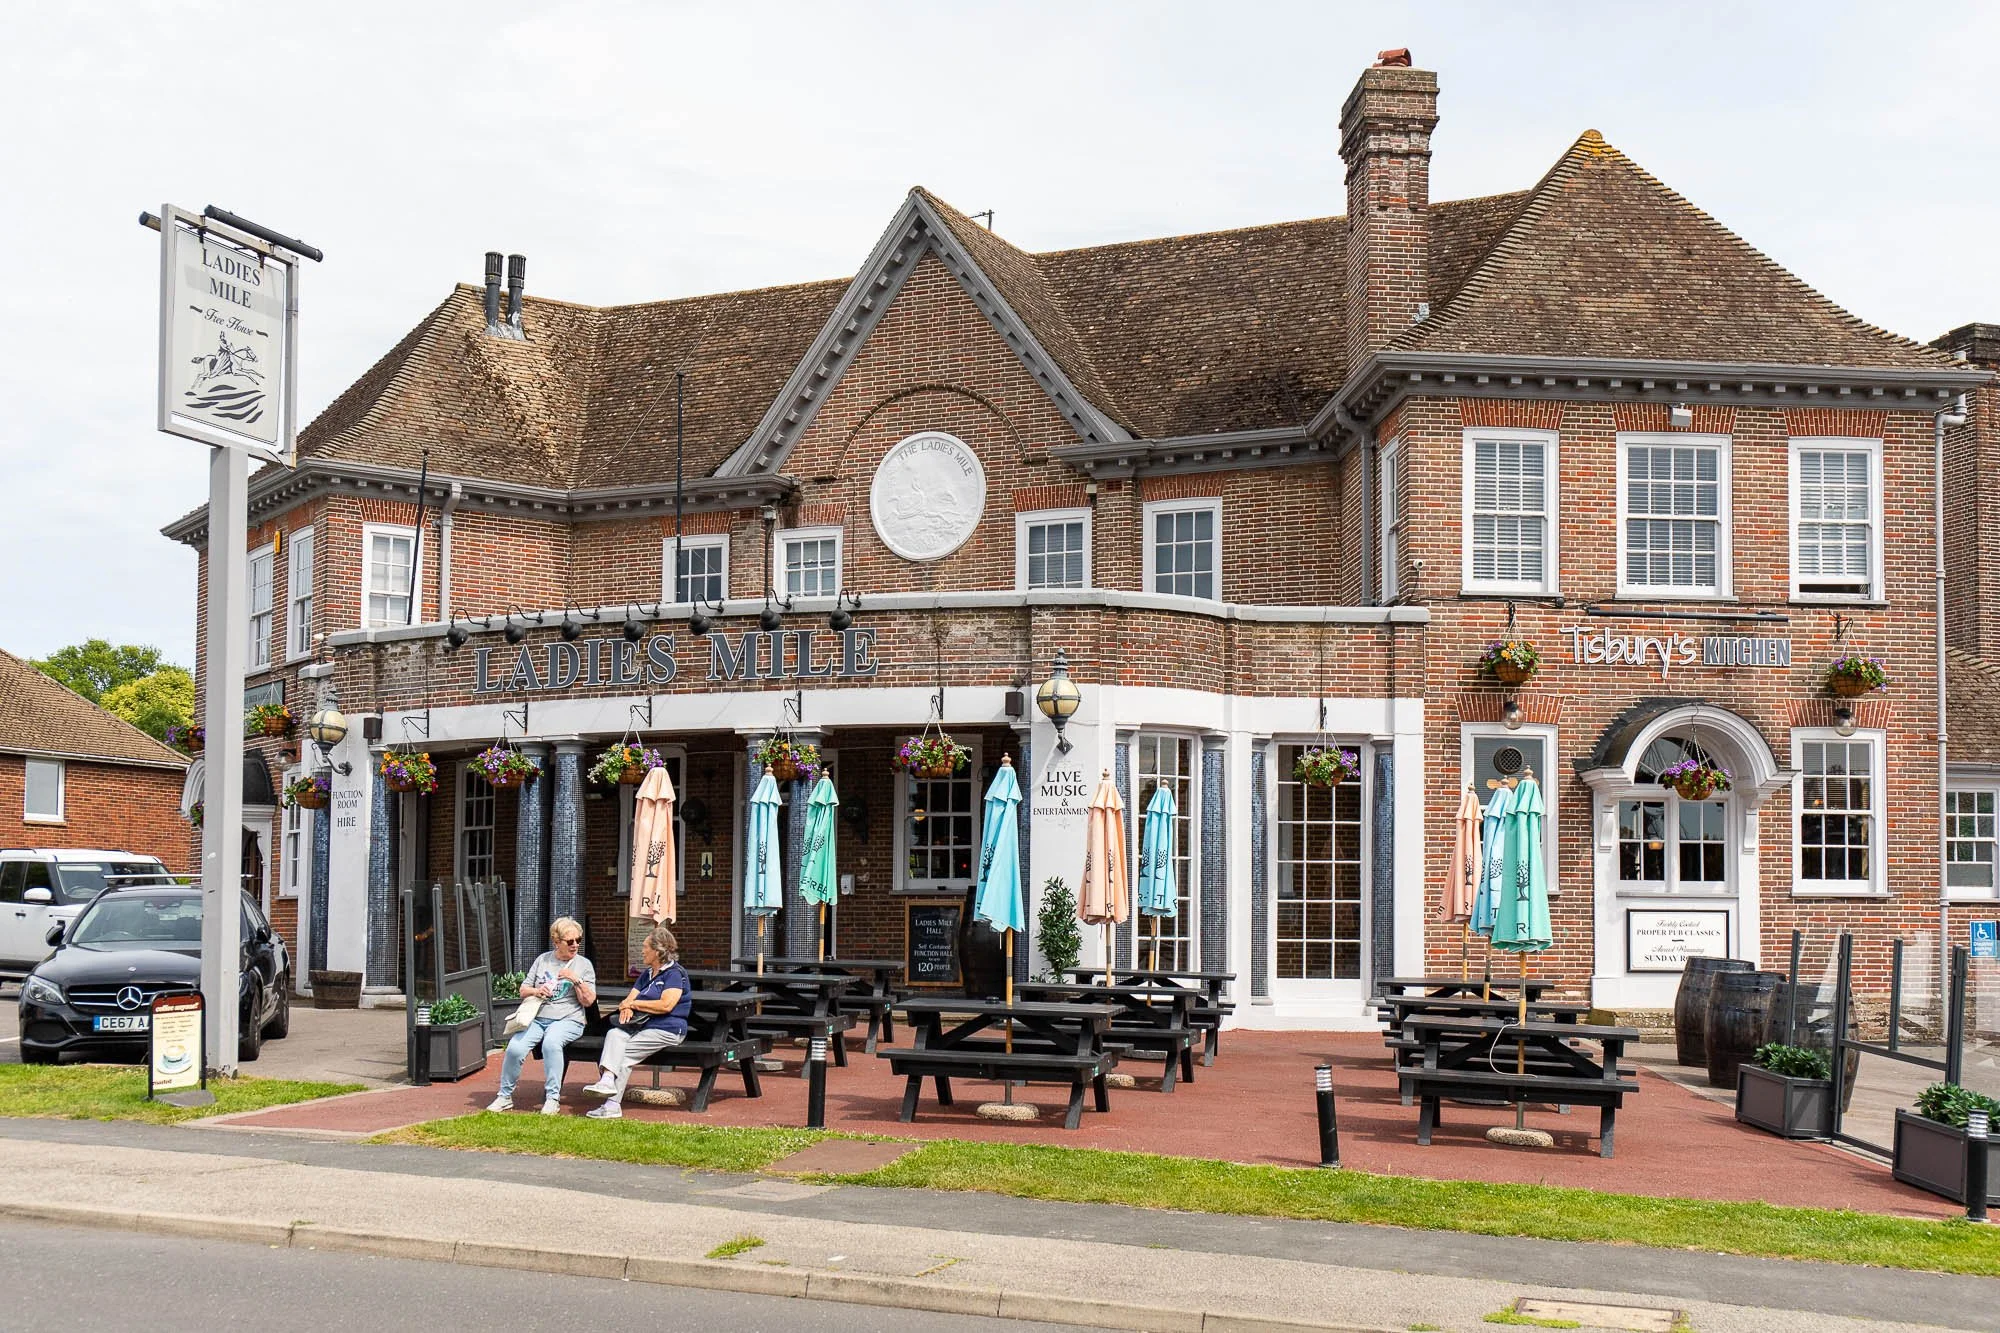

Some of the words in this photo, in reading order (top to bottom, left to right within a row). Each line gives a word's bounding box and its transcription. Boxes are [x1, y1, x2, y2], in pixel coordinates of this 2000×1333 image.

[202, 248, 260, 287] LADIES
[209, 277, 251, 309] MILE
[204, 308, 225, 326] Free
[226, 317, 254, 336] House
[898, 444, 917, 460] THE
[921, 440, 955, 456] LADIES
[954, 453, 974, 477] MILE
[1559, 626, 1697, 679] Tisbury's
[1703, 637, 1792, 667] KITCHEN
[473, 632, 677, 695] LADIES
[706, 627, 879, 682] MILE
[1047, 771, 1082, 782] LIVE
[332, 790, 363, 800] FUNCTION
[1041, 784, 1088, 796] MUSIC
[337, 799, 357, 808] ROOM
[1061, 797, 1069, 807] &
[1033, 807, 1088, 815] ENTERTAINMEN
[337, 816, 356, 827] HIRE
[1644, 954, 1677, 962] SUNDAY
[918, 962, 933, 972] 120
[101, 1017, 134, 1029] CE67
